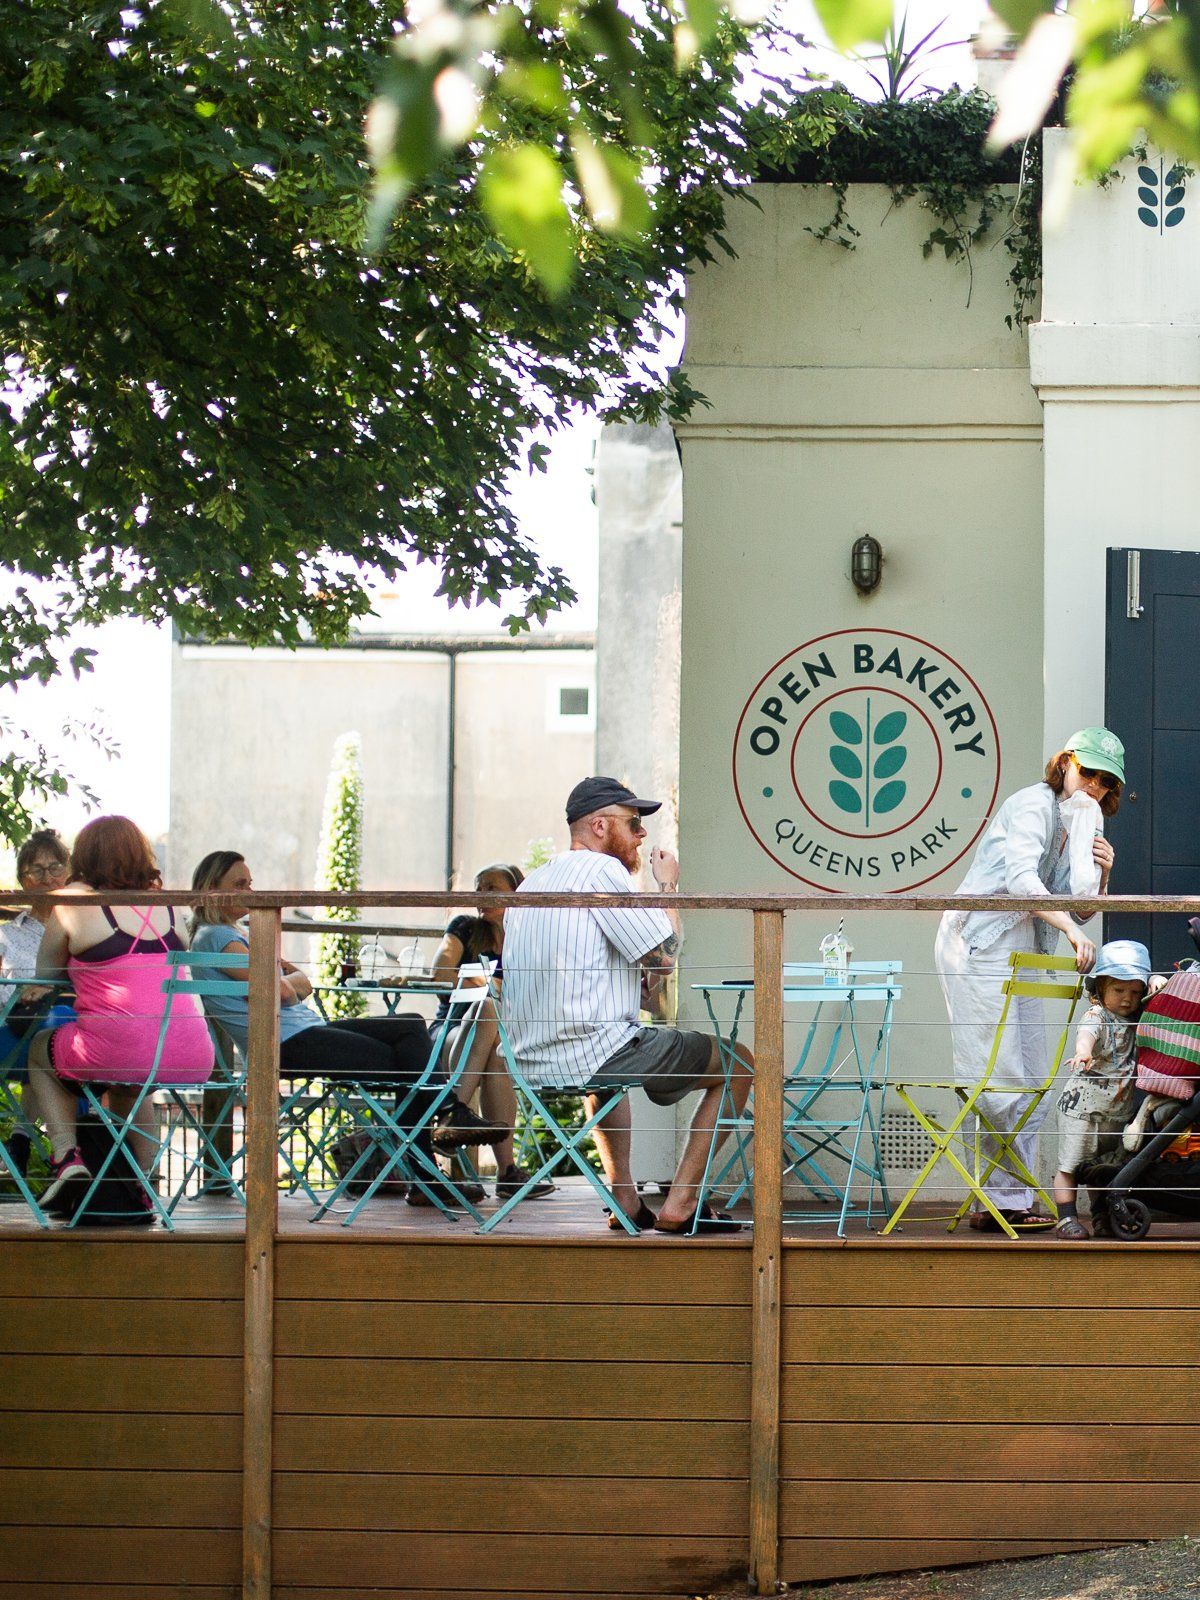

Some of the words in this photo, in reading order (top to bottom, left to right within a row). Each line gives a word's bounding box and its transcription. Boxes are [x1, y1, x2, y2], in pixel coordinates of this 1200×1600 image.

[750, 652, 837, 756] OPEN
[853, 643, 986, 757] BAKERY
[775, 818, 881, 877] QUEENS
[891, 817, 958, 872] PARK
